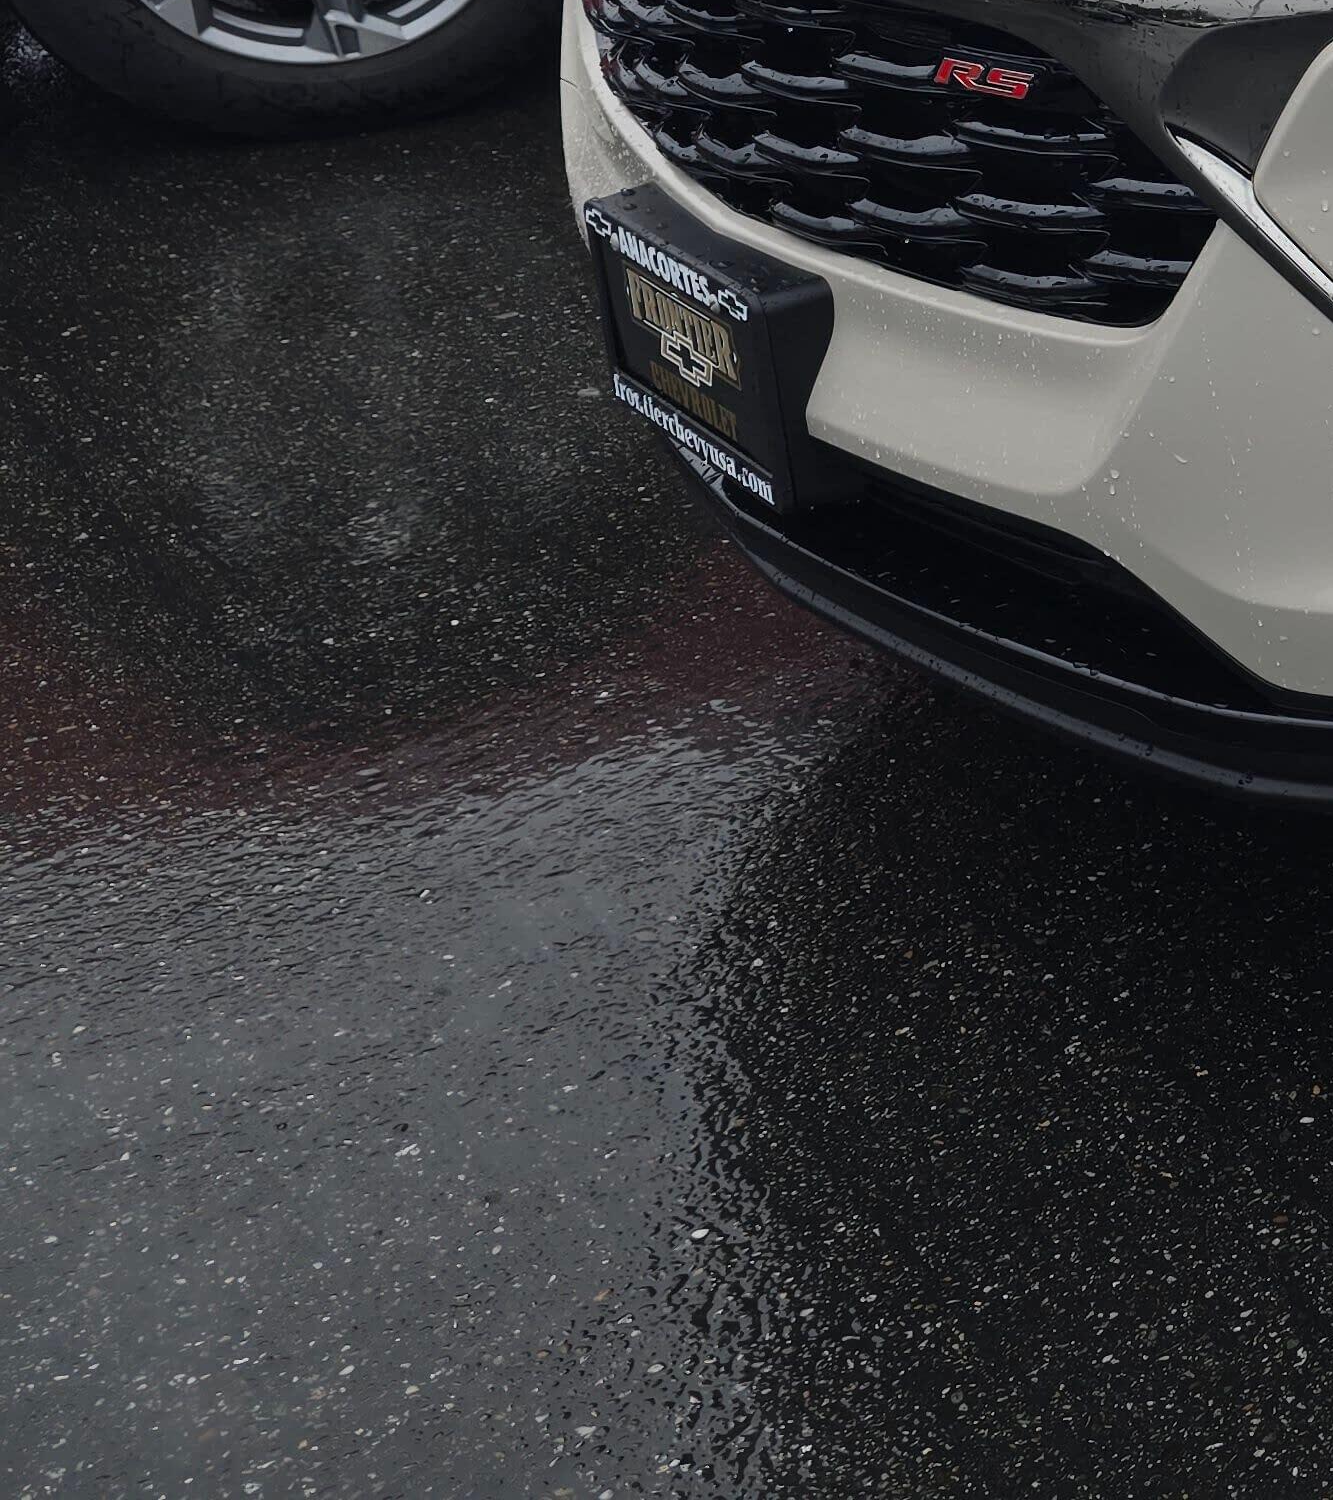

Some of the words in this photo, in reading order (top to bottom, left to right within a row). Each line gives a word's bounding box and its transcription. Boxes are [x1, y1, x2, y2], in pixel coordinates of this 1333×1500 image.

[934, 56, 1035, 100] RS
[617, 225, 711, 307] ANACORTES
[613, 373, 776, 506] frontierchevyusa.com
